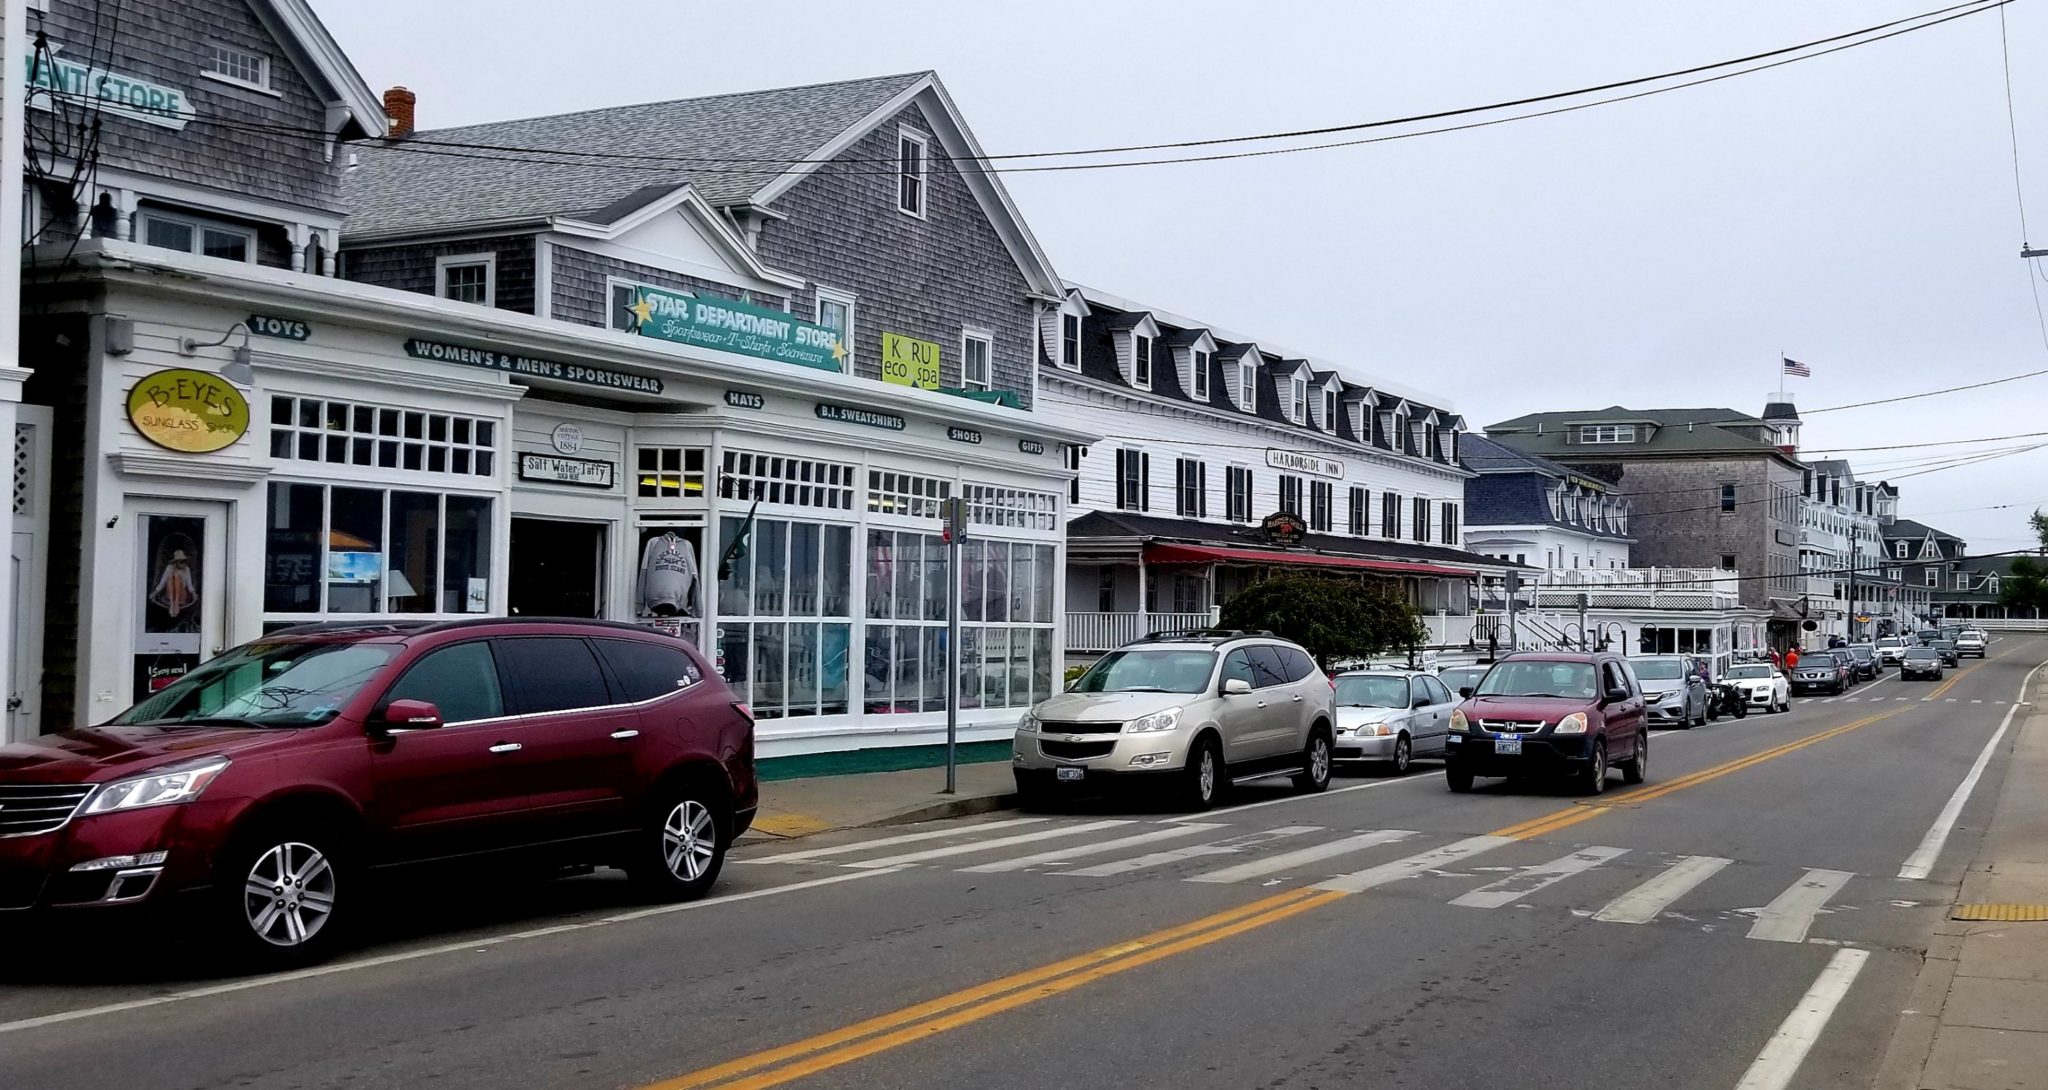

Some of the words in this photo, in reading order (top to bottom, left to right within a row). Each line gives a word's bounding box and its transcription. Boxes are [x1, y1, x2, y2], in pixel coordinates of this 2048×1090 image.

[96, 75, 180, 118] STORE
[256, 316, 305, 338] TOYS
[646, 293, 689, 320] STAR
[694, 304, 790, 340] DEPARTMENT
[796, 327, 837, 350] STORE
[661, 319, 722, 344] Sportswear
[415, 341, 494, 366] WOMEN'S
[500, 355, 511, 368] &
[516, 358, 561, 377] MEN'S
[567, 365, 660, 392] SPORTSWEAR
[884, 360, 907, 378] eco
[917, 367, 937, 387] spa
[147, 378, 236, 417] B-EYES
[730, 393, 761, 408] HATS
[142, 415, 199, 431] SUNGLASS
[822, 405, 838, 418] B.I.
[841, 409, 903, 429] SWEATSHIRTS
[560, 440, 577, 451] 1884
[952, 429, 980, 443] SHOES
[1022, 440, 1043, 453] GIFTS
[528, 457, 549, 471] Salt
[552, 460, 577, 473] Water
[580, 462, 607, 482] Taffy
[1273, 452, 1320, 472] HARBORSIDE
[1325, 463, 1338, 475] INN
